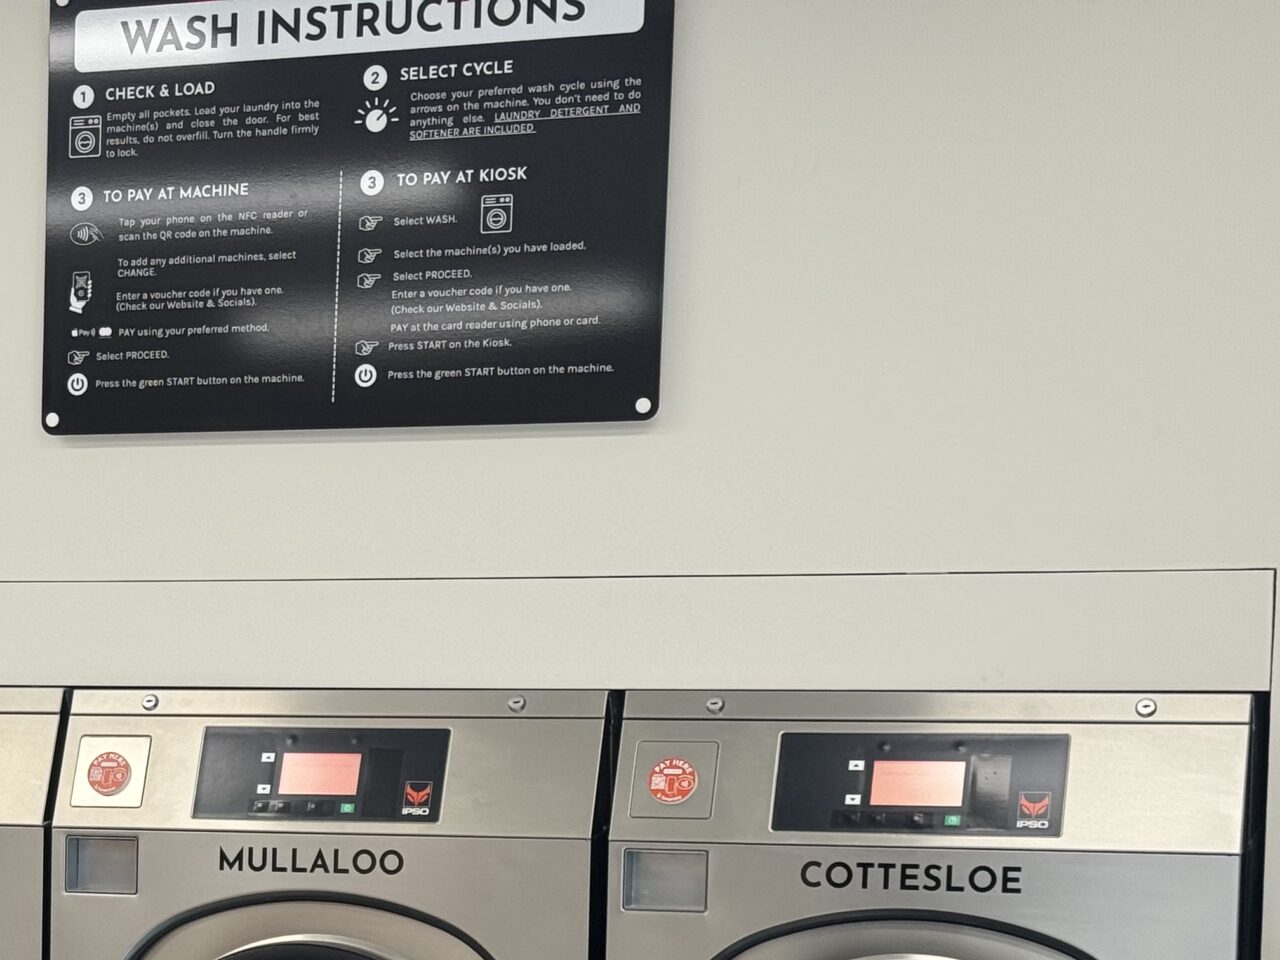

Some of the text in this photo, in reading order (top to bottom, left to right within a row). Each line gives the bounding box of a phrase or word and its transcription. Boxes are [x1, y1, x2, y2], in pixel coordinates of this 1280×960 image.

[120, 0, 586, 56] WASH INSTRUCTIONS
[370, 59, 513, 84] 2 SELECT CYCLE
[80, 81, 214, 103] 1 CHECK & LOAD
[410, 76, 641, 101] Choose your preferred wash cycle using the
[410, 104, 443, 114] arrows
[446, 103, 459, 111] on
[463, 101, 479, 110] the
[532, 97, 550, 105] You
[585, 91, 609, 102] need
[614, 92, 624, 100] to
[628, 89, 641, 99] do
[106, 111, 136, 122] Empty
[138, 109, 150, 120] all
[194, 105, 216, 116] Load
[218, 105, 240, 118] your
[243, 102, 278, 114] laundry
[281, 101, 301, 110] into
[304, 99, 319, 113] the
[409, 115, 453, 128] anything
[494, 110, 540, 120] LAUNDRY
[550, 106, 608, 117] DETERGENT
[618, 105, 640, 113] AND
[106, 112, 319, 133] machine(s) and close the door. For best
[409, 128, 459, 138] SOFTENER
[462, 127, 481, 135] ARE
[368, 166, 527, 189] 3 TO PAY AT KIOSK
[78, 182, 248, 205] 3 TO PAY AT MACHINE
[393, 216, 423, 226] Select
[393, 240, 586, 258] Select the machine(s) you have loaded.
[117, 258, 128, 267] To
[130, 257, 147, 266] add
[150, 258, 166, 267] any
[168, 254, 215, 264] additional
[268, 250, 296, 260] select
[393, 271, 422, 281] Select
[116, 292, 140, 300] Enter
[149, 289, 187, 299] voucher
[188, 288, 210, 297] code
[212, 288, 219, 296] if
[221, 289, 238, 299] you
[240, 287, 262, 296] have
[116, 301, 147, 312] (Check
[149, 302, 165, 310] our
[166, 299, 204, 309] Website
[206, 299, 215, 307] &
[118, 328, 135, 336] PAY
[137, 327, 163, 338] using
[164, 327, 185, 338] your
[187, 324, 228, 336] preferred
[388, 340, 414, 350] Press
[417, 340, 447, 349] START
[464, 339, 480, 348] the
[482, 337, 512, 347] Kiosk.
[96, 351, 123, 360] Select
[387, 370, 413, 378] Press
[416, 369, 432, 378] the
[434, 369, 462, 380] green
[464, 366, 495, 376] START
[497, 366, 530, 375] button
[548, 364, 564, 373] the
[654, 760, 670, 773] PAY
[672, 759, 693, 774] HERE
[402, 807, 430, 816] IPSO
[1016, 820, 1049, 829] IPSO
[219, 846, 405, 876] MULLALOO
[799, 860, 1024, 895] COTTESLOE
